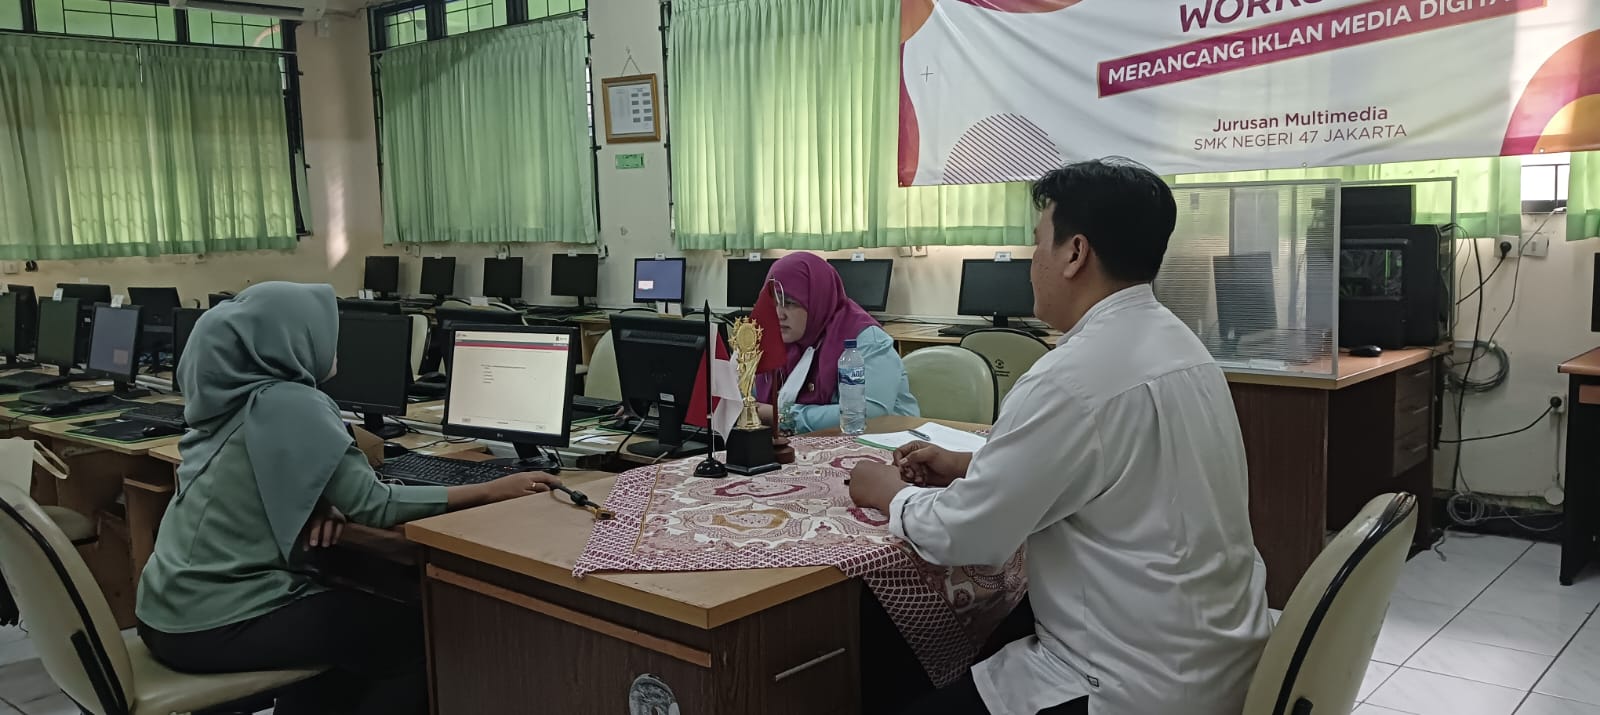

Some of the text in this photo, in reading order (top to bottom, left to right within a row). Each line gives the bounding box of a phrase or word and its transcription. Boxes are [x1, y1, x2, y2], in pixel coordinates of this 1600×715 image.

[1108, 41, 1245, 85] MERANCANG
[1251, 23, 1323, 55] IKLAN
[1331, 5, 1412, 38] MEDIA
[1213, 106, 1388, 132] Jurusan Multimedia
[1194, 124, 1408, 151] SMK NEGERI 47 JAKARTA
